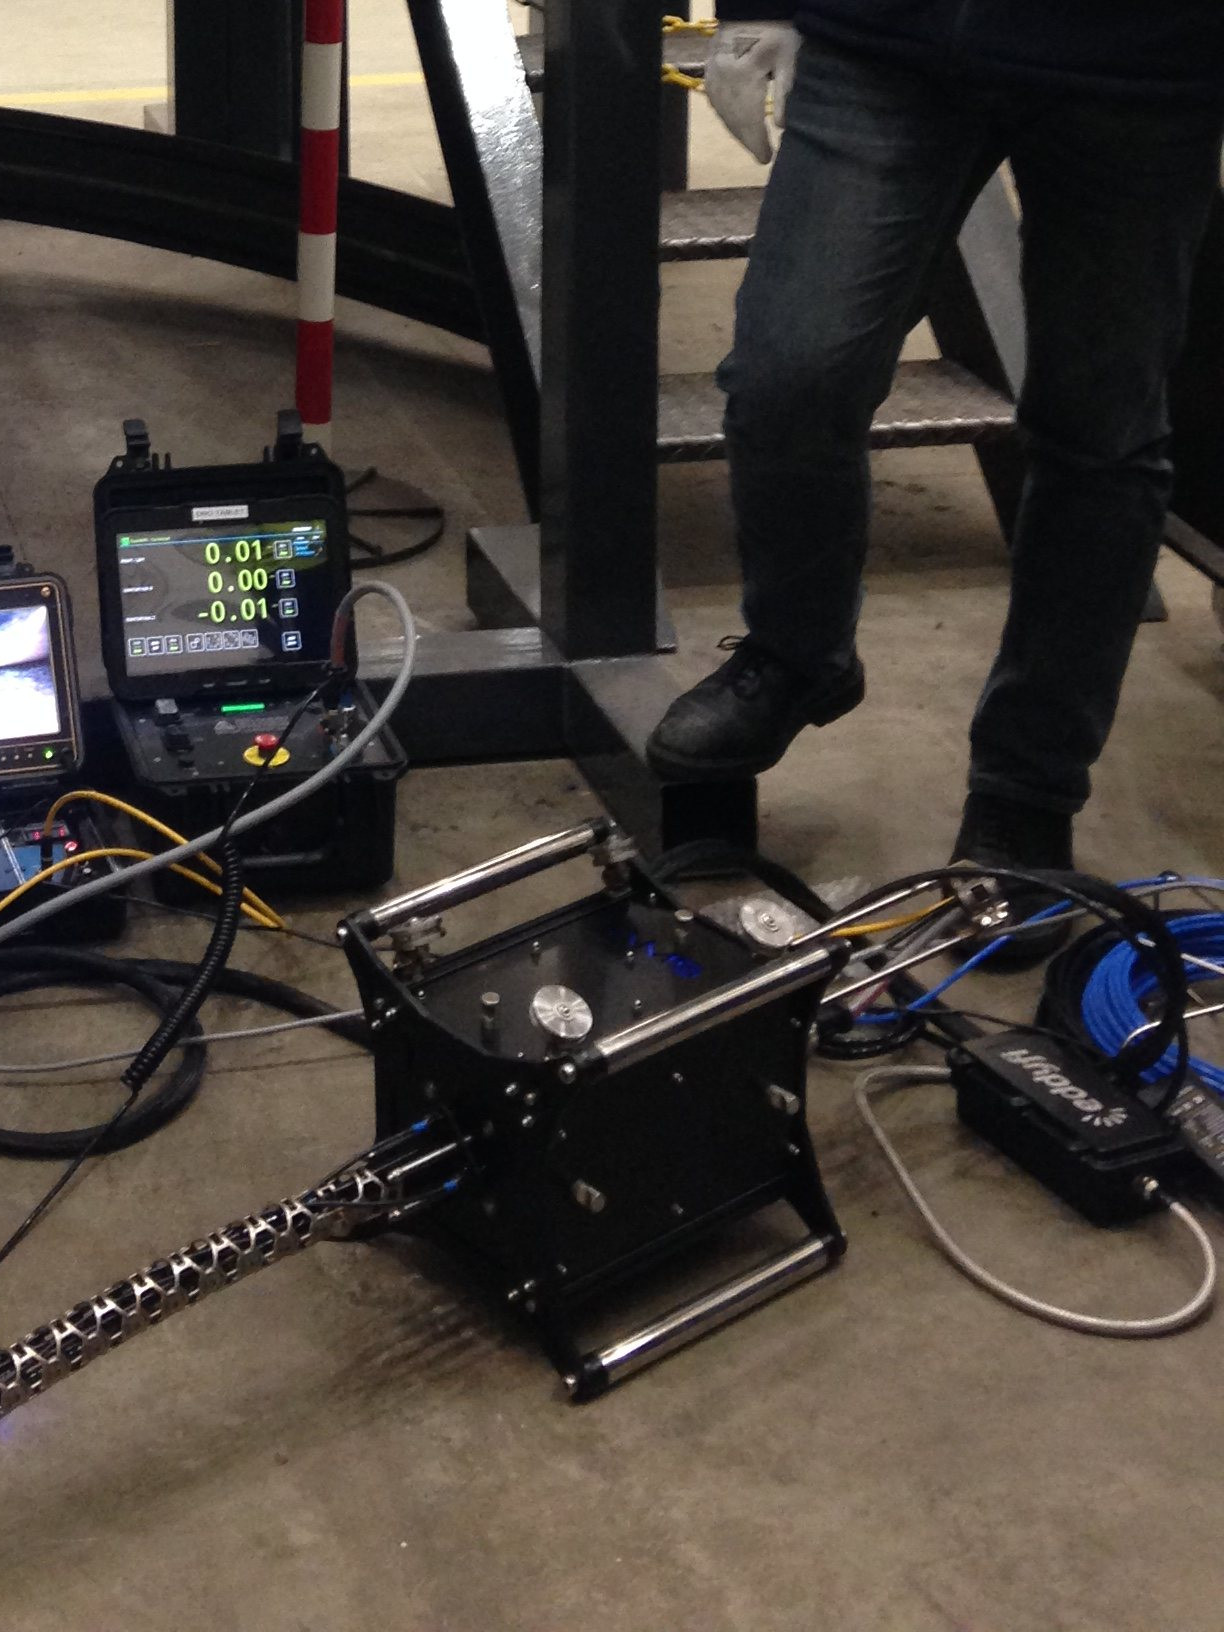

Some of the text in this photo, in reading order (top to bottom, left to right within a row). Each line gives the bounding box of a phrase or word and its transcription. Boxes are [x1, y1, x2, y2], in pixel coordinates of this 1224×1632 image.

[205, 539, 262, 564] 0.01
[207, 568, 268, 593] 0.00
[197, 597, 267, 623] -0.01
